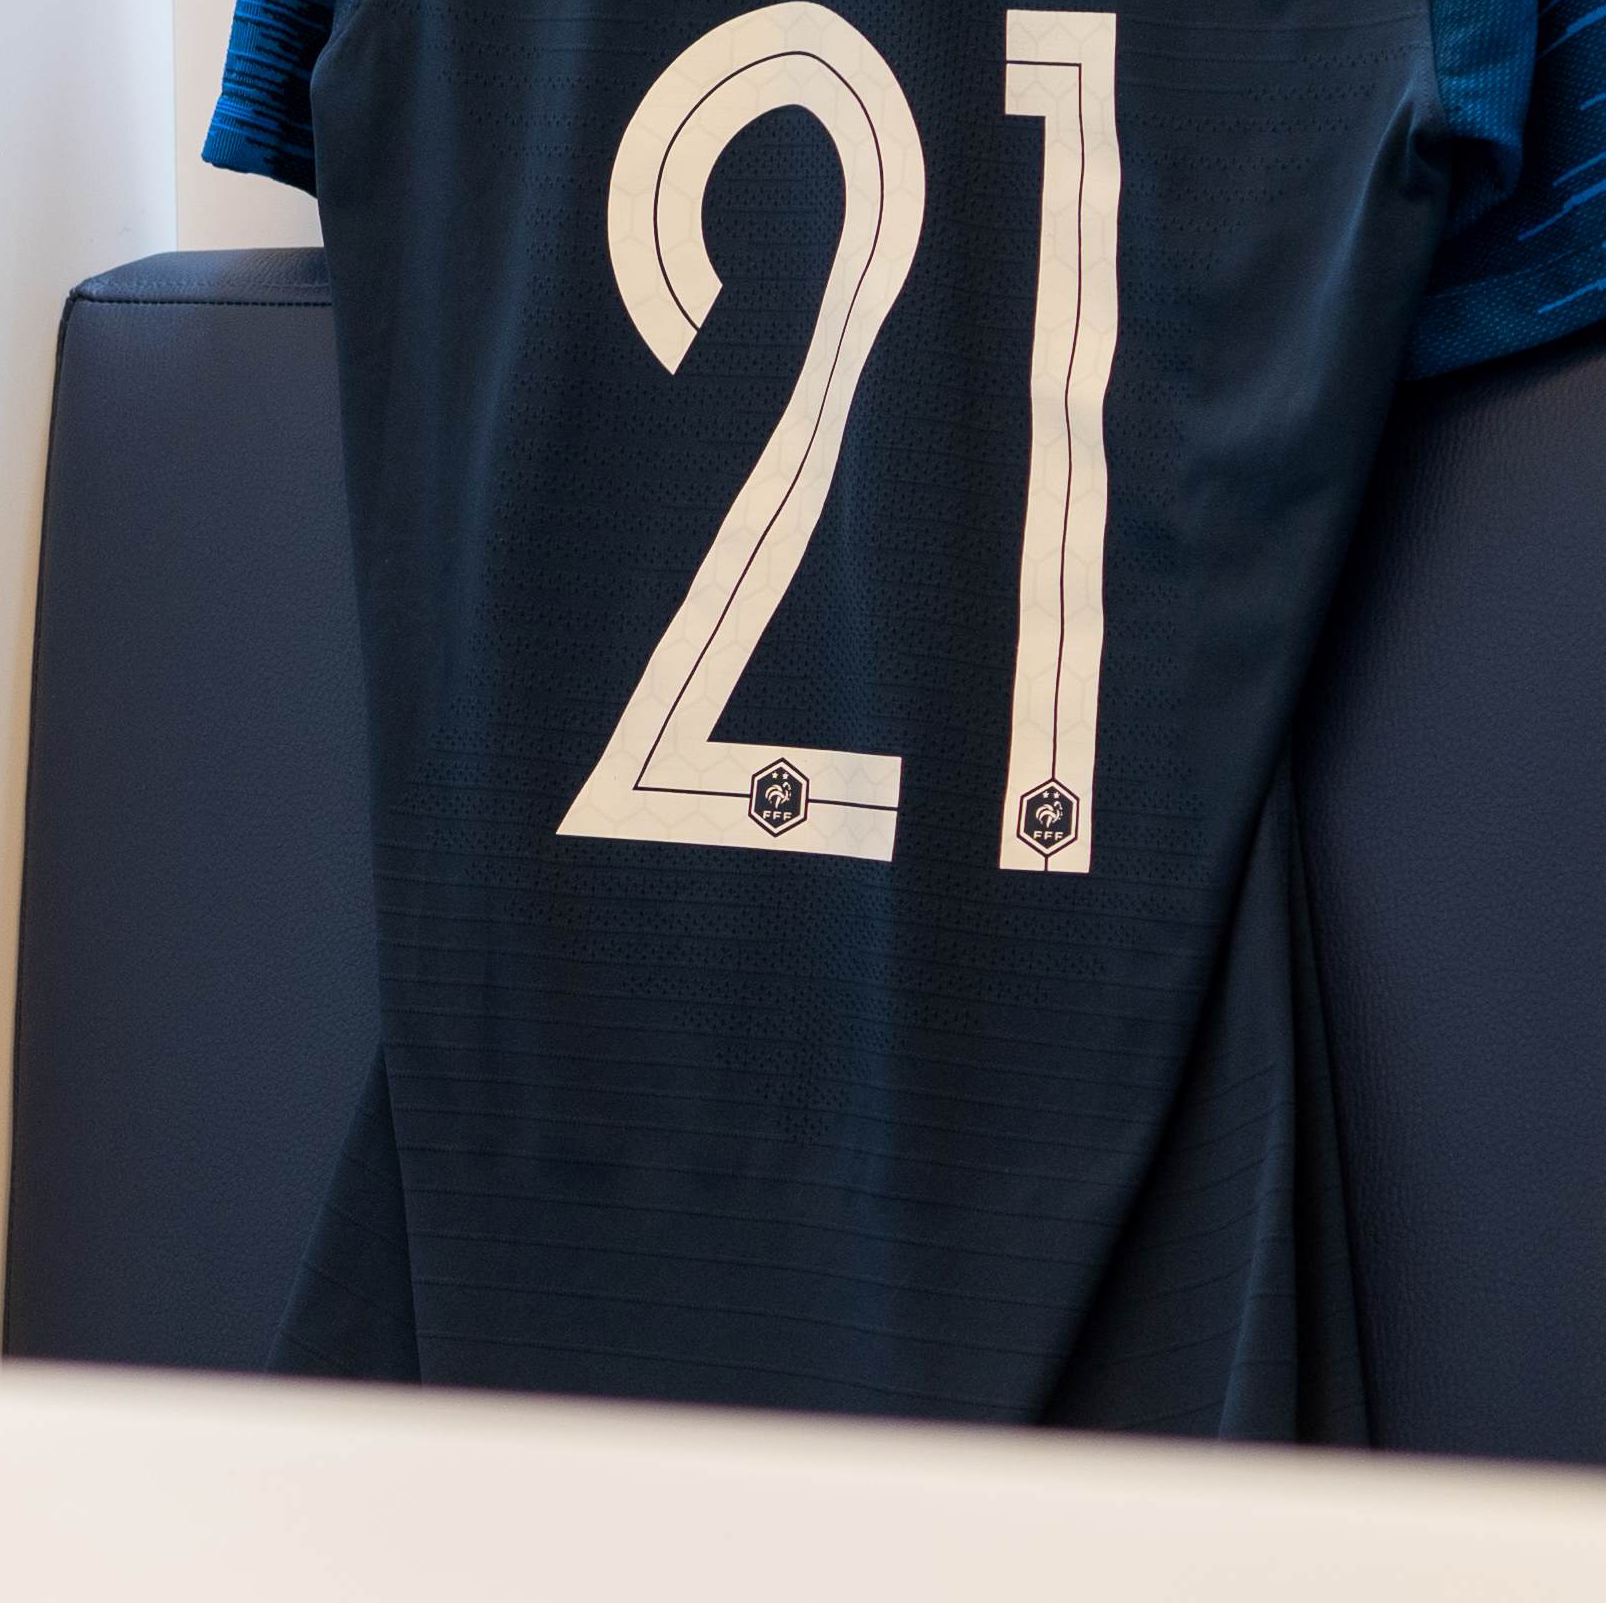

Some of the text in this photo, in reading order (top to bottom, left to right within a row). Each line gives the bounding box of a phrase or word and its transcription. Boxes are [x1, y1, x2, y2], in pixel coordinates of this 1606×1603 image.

[555, 0, 1122, 874] 21
[762, 810, 793, 822] FFF
[1033, 830, 1064, 842] FFF
